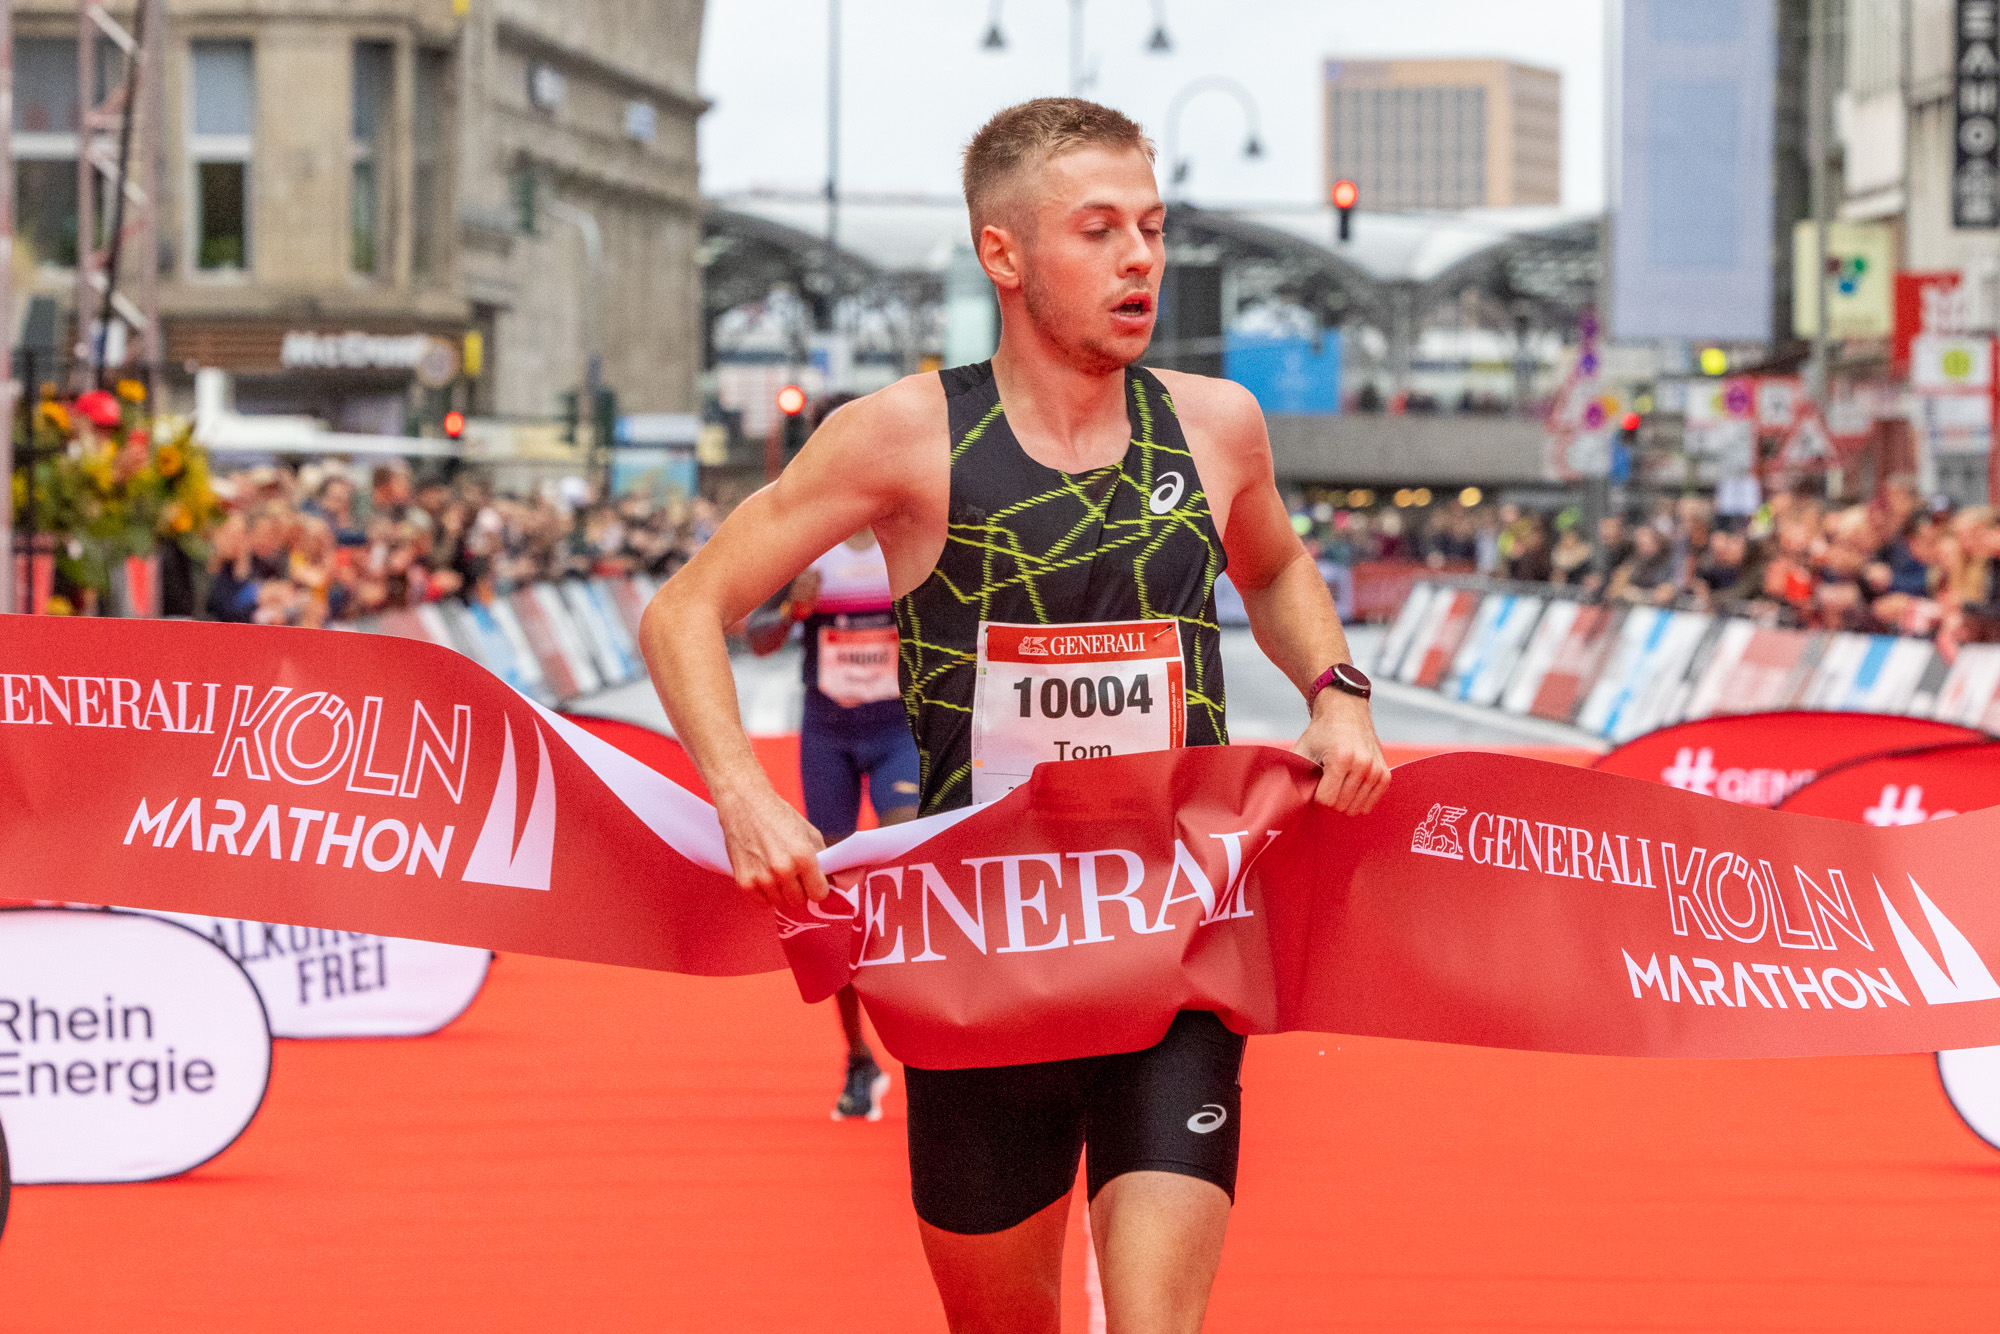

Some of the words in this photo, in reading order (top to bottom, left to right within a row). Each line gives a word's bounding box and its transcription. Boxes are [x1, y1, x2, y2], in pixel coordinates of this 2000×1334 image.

[1050, 632, 1146, 656] GENERALI
[1013, 673, 1153, 719] 10004
[213, 683, 471, 805] KÖLN
[1053, 741, 1112, 761] Tom
[123, 797, 455, 879] MARATHON
[1468, 812, 1656, 889] GENERALI
[1661, 842, 1875, 951] KÖLN
[298, 944, 386, 1004] FREI
[1621, 947, 1911, 1010] MARATHON
[0, 996, 154, 1042] Rhein
[0, 1047, 215, 1105] Energie
